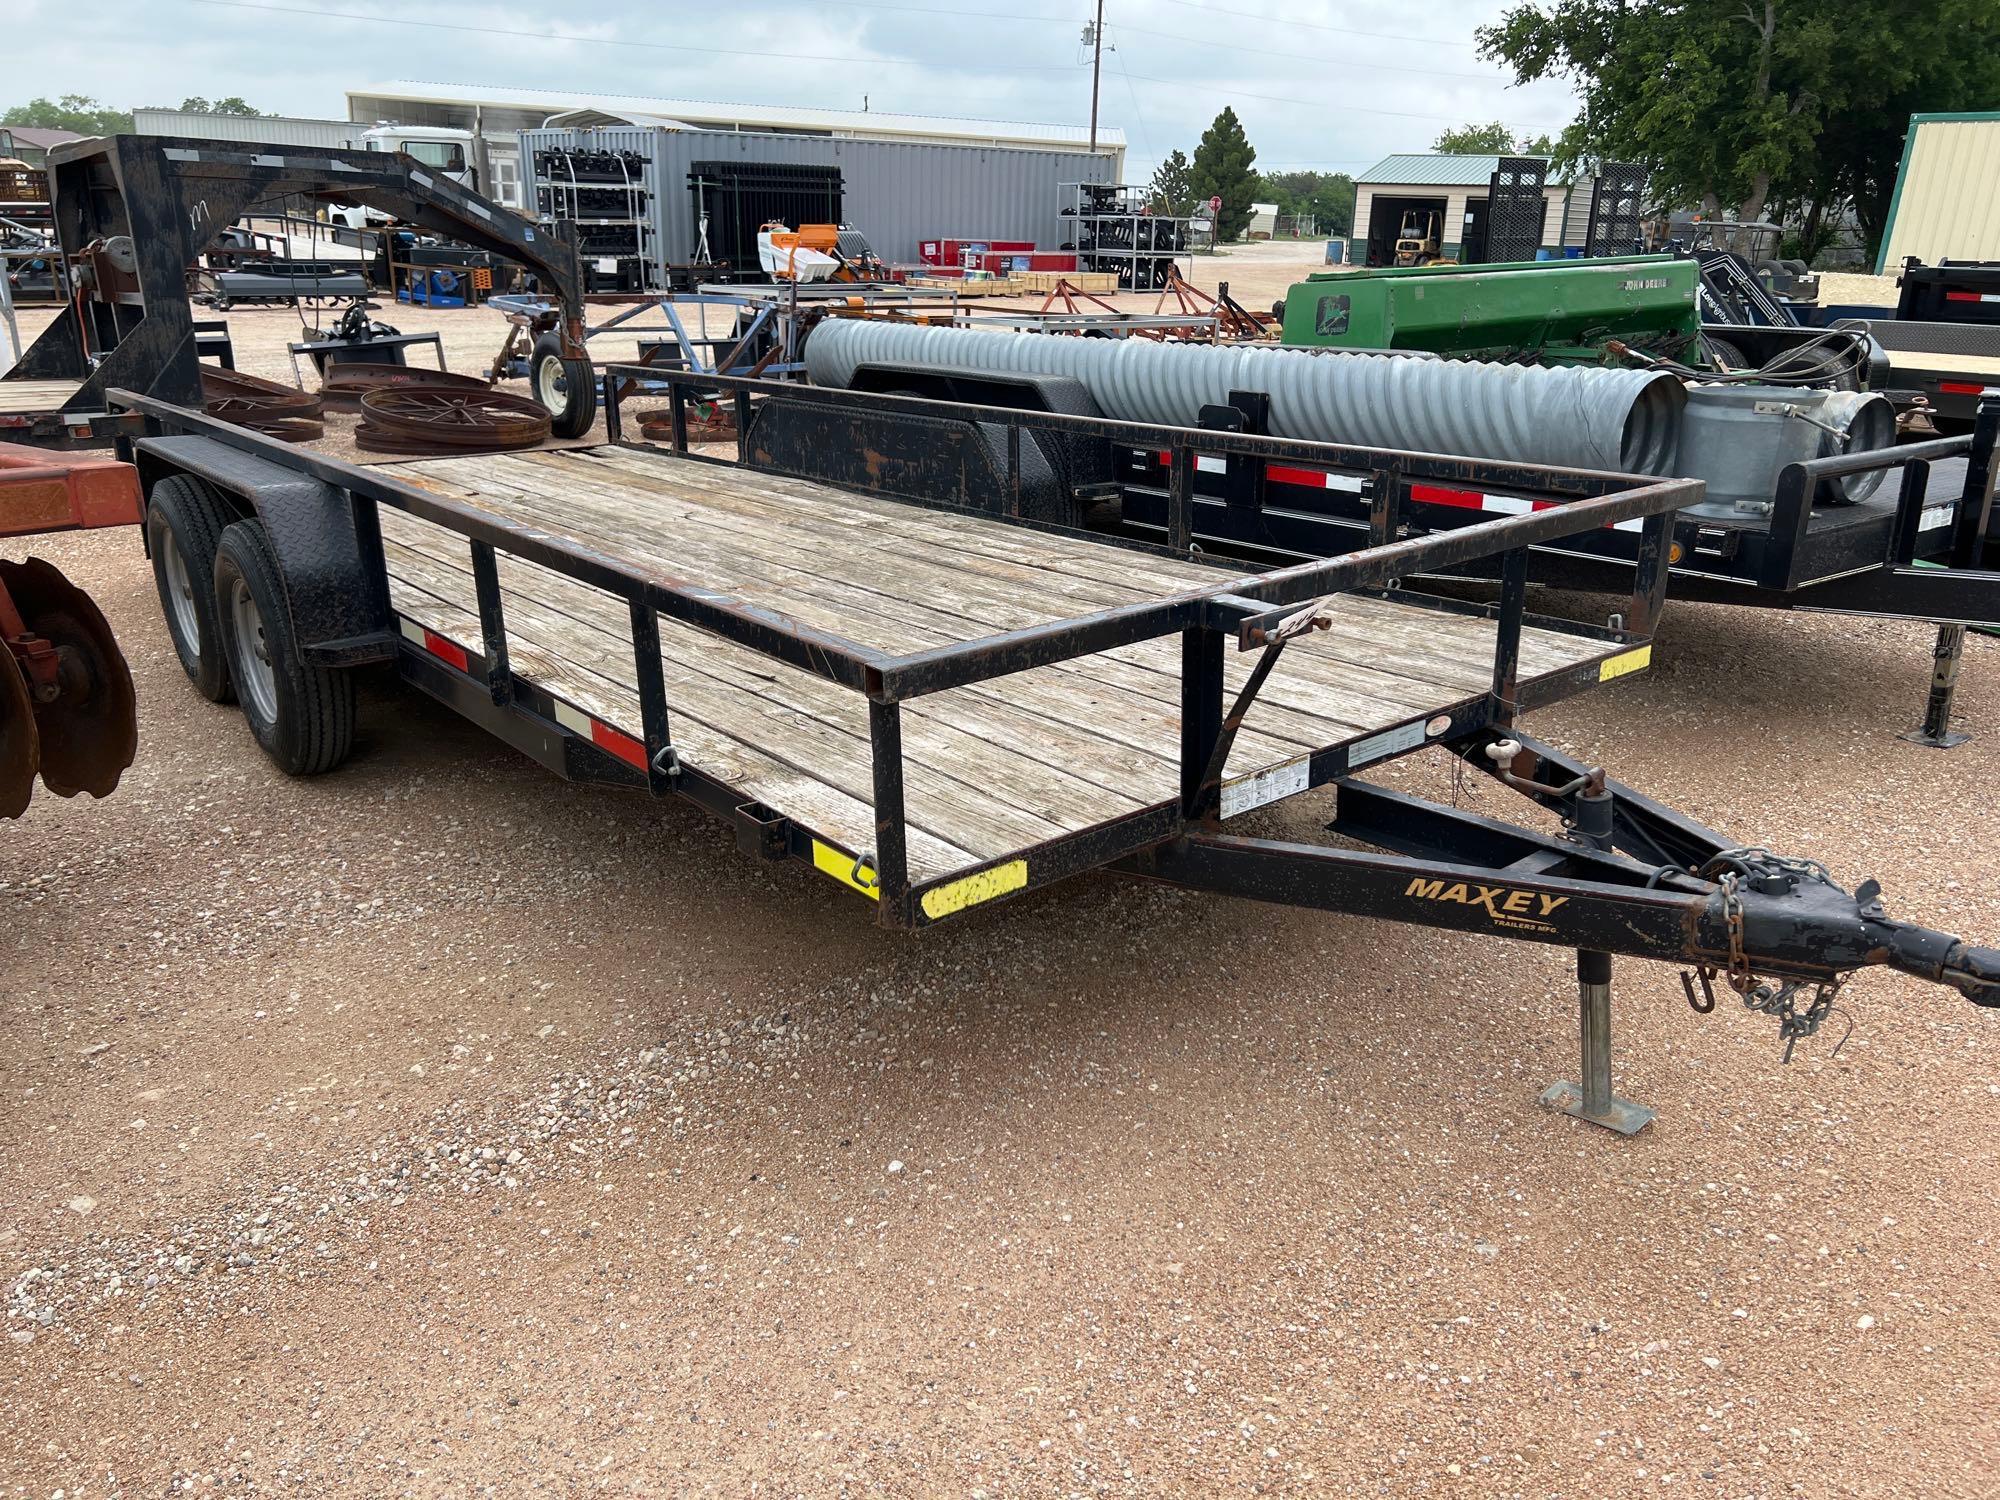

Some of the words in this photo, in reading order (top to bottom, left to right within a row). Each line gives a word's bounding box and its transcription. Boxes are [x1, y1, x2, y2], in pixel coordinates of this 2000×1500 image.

[1624, 280, 1643, 290] JOHN
[1645, 278, 1667, 289] DEERE
[1405, 877, 1570, 917] MAXEY
[1494, 919, 1536, 931] TRAILERS
